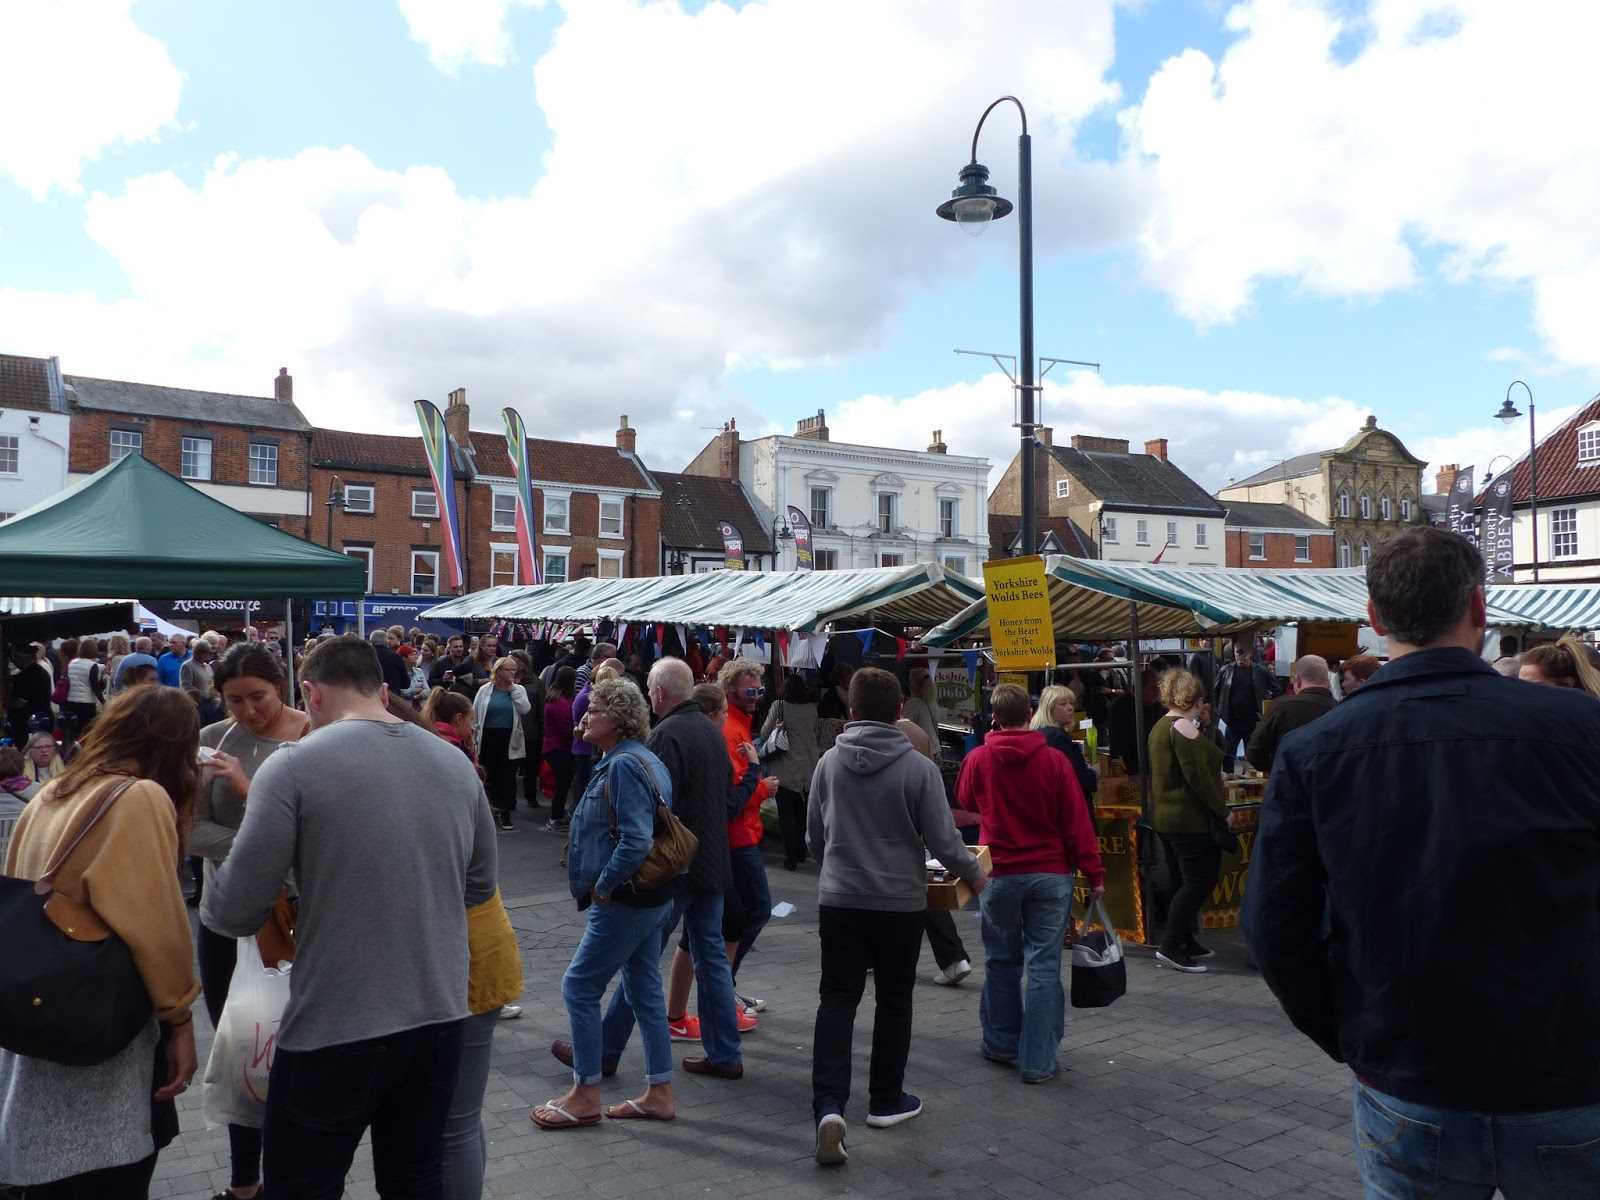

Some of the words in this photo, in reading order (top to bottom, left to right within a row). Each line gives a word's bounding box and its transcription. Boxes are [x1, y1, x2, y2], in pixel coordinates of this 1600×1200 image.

[1485, 508, 1497, 583] AMPLEFORTH
[1497, 514, 1512, 577] ABBEY
[992, 577, 1038, 591] Yorkshire
[990, 591, 1020, 603] Wolds
[1022, 590, 1044, 600] Bees
[999, 618, 1022, 628] Honey
[1024, 616, 1042, 625] from
[1018, 627, 1038, 635] Heart
[1011, 638, 1019, 646] of
[1020, 637, 1033, 645] The
[995, 647, 1028, 657] Yorkshire
[1030, 646, 1053, 655] Wolds
[934, 672, 971, 685] rkshire
